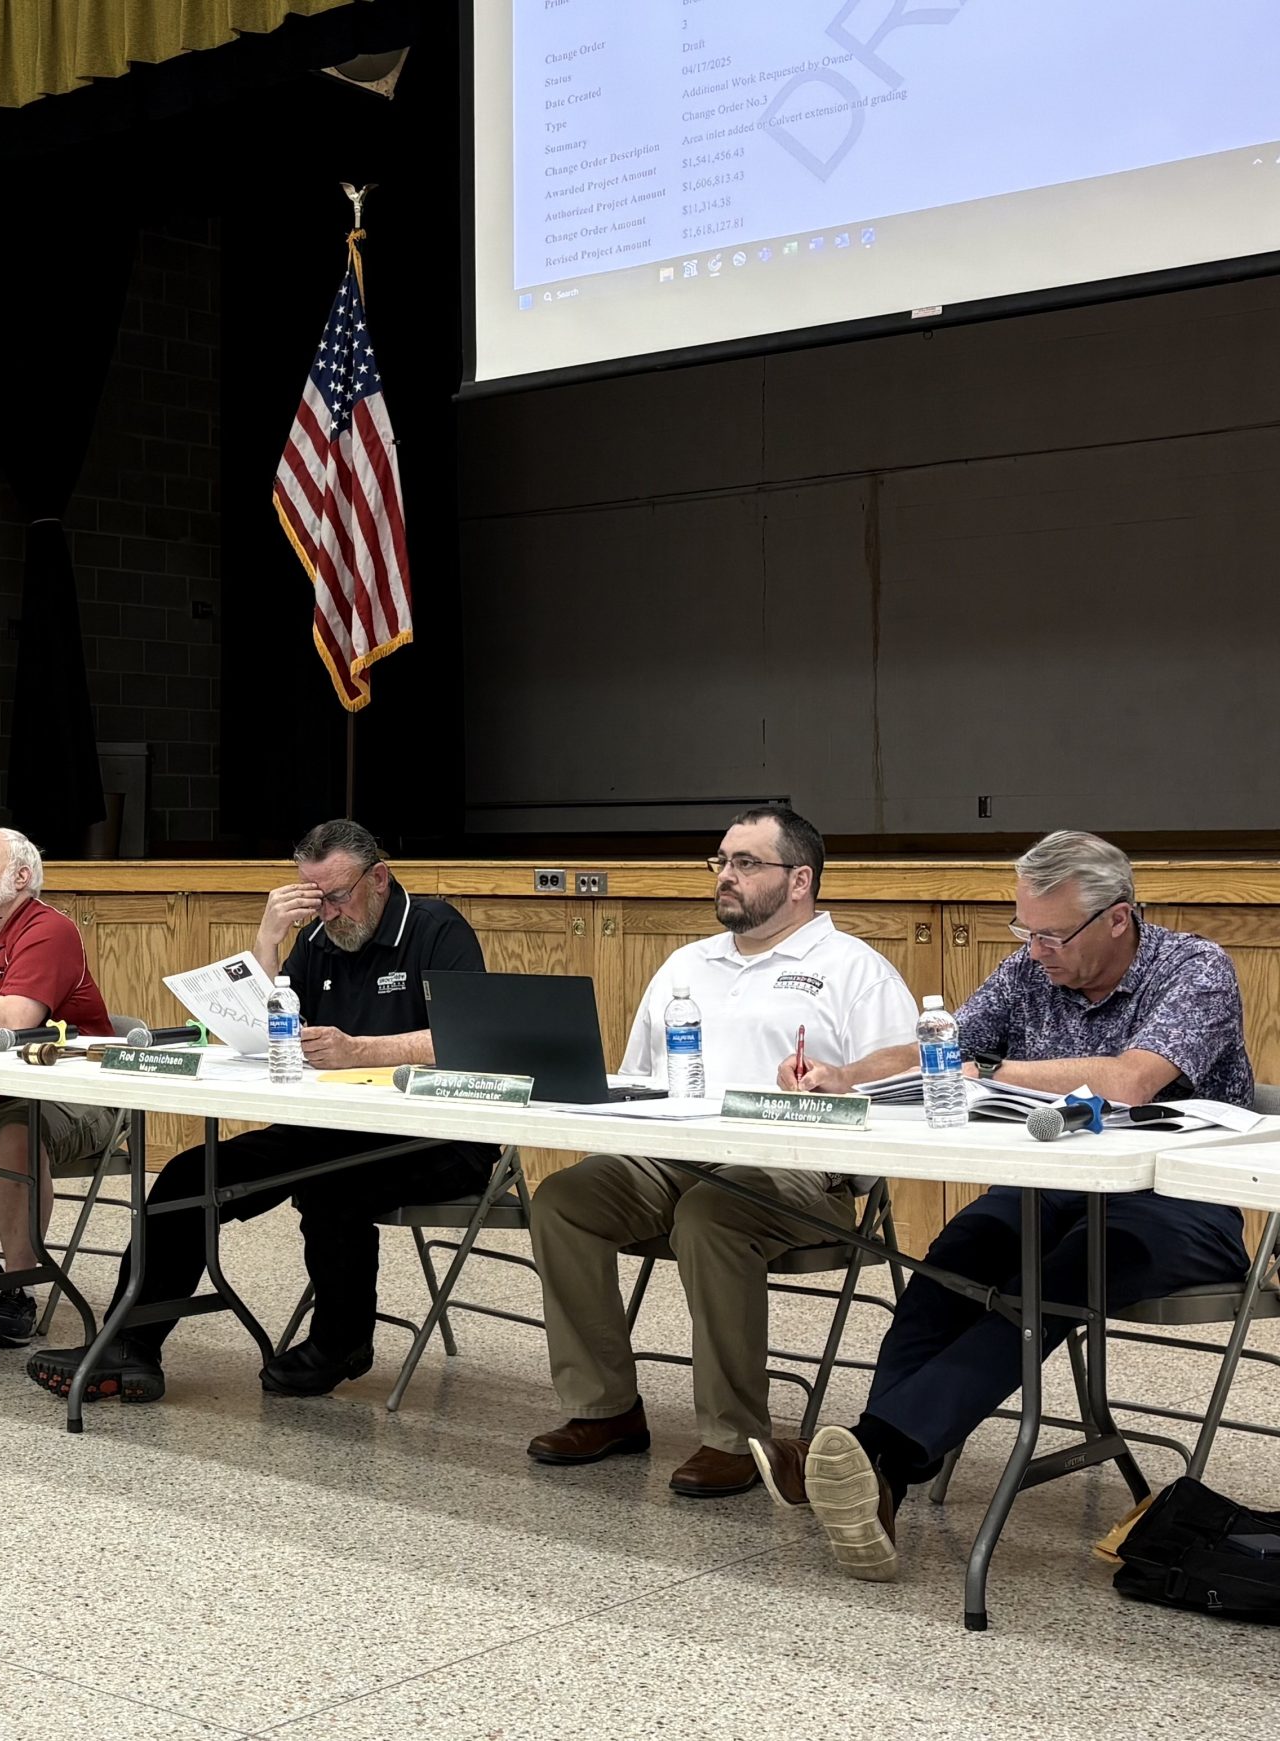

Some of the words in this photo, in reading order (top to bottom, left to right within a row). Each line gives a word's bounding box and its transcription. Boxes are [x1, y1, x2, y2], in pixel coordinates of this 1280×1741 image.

[545, 51, 577, 65] Change
[579, 41, 606, 55] Order
[682, 40, 705, 53] Draft
[682, 56, 732, 76] 04/17/2025
[682, 79, 729, 99] Additional
[731, 74, 756, 88] Work
[759, 63, 805, 83] Requested
[807, 59, 819, 72] by
[821, 53, 853, 67] Owner
[544, 75, 572, 88] Status
[545, 99, 565, 110] Date
[567, 87, 602, 104] Created
[682, 109, 716, 123] Change
[718, 101, 744, 115] Order
[746, 95, 768, 109] No.3
[545, 121, 567, 134] Type
[682, 134, 704, 146] Area
[706, 128, 726, 141] inlet
[727, 122, 755, 137] added
[804, 103, 849, 120] extension
[851, 96, 869, 109] and
[870, 88, 908, 108] grading
[544, 138, 588, 155] Summary
[544, 163, 578, 177] Change
[580, 157, 608, 170] Order
[610, 144, 660, 163] Description
[682, 147, 745, 169] $1,541,456.43
[544, 183, 585, 200] Awarded
[587, 177, 619, 192] Project
[621, 167, 657, 183] Amount
[544, 205, 594, 223] Authorized
[596, 197, 628, 212] Project
[630, 188, 666, 204] Amount
[545, 231, 578, 245] Change
[580, 225, 608, 238] Order
[610, 216, 646, 231] Amount
[545, 253, 579, 267] Revised
[581, 246, 613, 261] Project
[615, 238, 652, 253] Amount
[556, 288, 579, 300] Search
[208, 1001, 268, 1028] DRAF
[119, 1050, 135, 1062] Rod
[139, 1052, 183, 1065] Sonnichsen
[139, 1063, 158, 1072] Mayor
[434, 1075, 463, 1088] David
[468, 1077, 508, 1091] Schmidt
[435, 1087, 450, 1098] City
[454, 1088, 502, 1100] Administrator
[756, 1096, 791, 1109] Jason
[799, 1098, 833, 1112] White
[762, 1110, 780, 1120] City
[784, 1111, 822, 1123] Attorney
